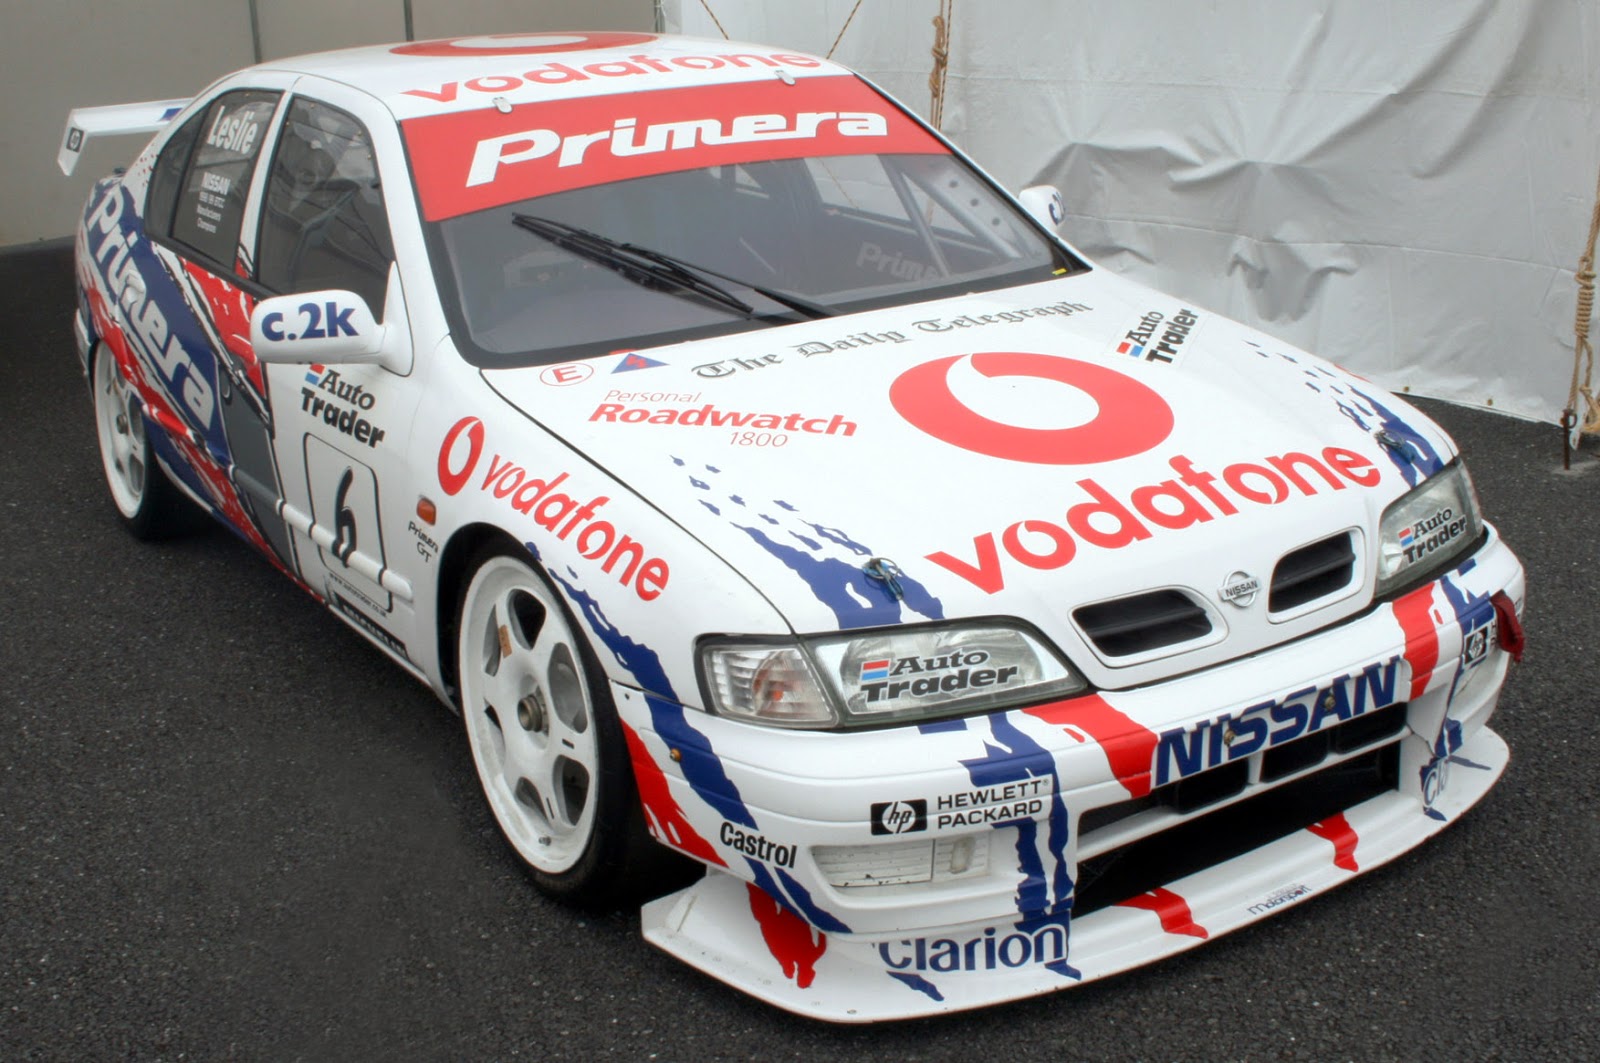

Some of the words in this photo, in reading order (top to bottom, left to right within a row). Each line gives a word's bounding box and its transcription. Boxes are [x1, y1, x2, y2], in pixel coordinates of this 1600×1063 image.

[400, 52, 821, 102] vodafone
[207, 105, 258, 154] Leslie
[465, 112, 887, 187] Primera
[87, 184, 214, 430] Primera
[261, 302, 360, 341] c.2k
[691, 353, 783, 378] The
[788, 329, 912, 358] Daily
[911, 301, 1093, 333] Telegraph
[1125, 311, 1164, 347] Auto
[1145, 308, 1198, 363] Trader
[318, 369, 375, 410] Auto
[552, 365, 582, 383] E
[604, 389, 701, 403] Personal
[301, 387, 385, 449] Trader
[588, 404, 857, 436] Roadwatch
[729, 432, 788, 447] 1800
[408, 521, 438, 553] Primera
[481, 454, 670, 601] vodafone
[924, 447, 1381, 595] vodafone
[1403, 517, 1466, 563] Trader
[1413, 508, 1452, 540] Auto
[417, 542, 432, 562] GT
[1225, 580, 1258, 597] NISSAN
[889, 649, 989, 676] Auto
[861, 665, 1018, 702] Trader
[1155, 655, 1401, 787] NISSAN
[937, 779, 1042, 810] HEWLETT
[937, 800, 1043, 829] PACKARD
[720, 822, 798, 869] Castrol
[879, 923, 1065, 973] Clarion
